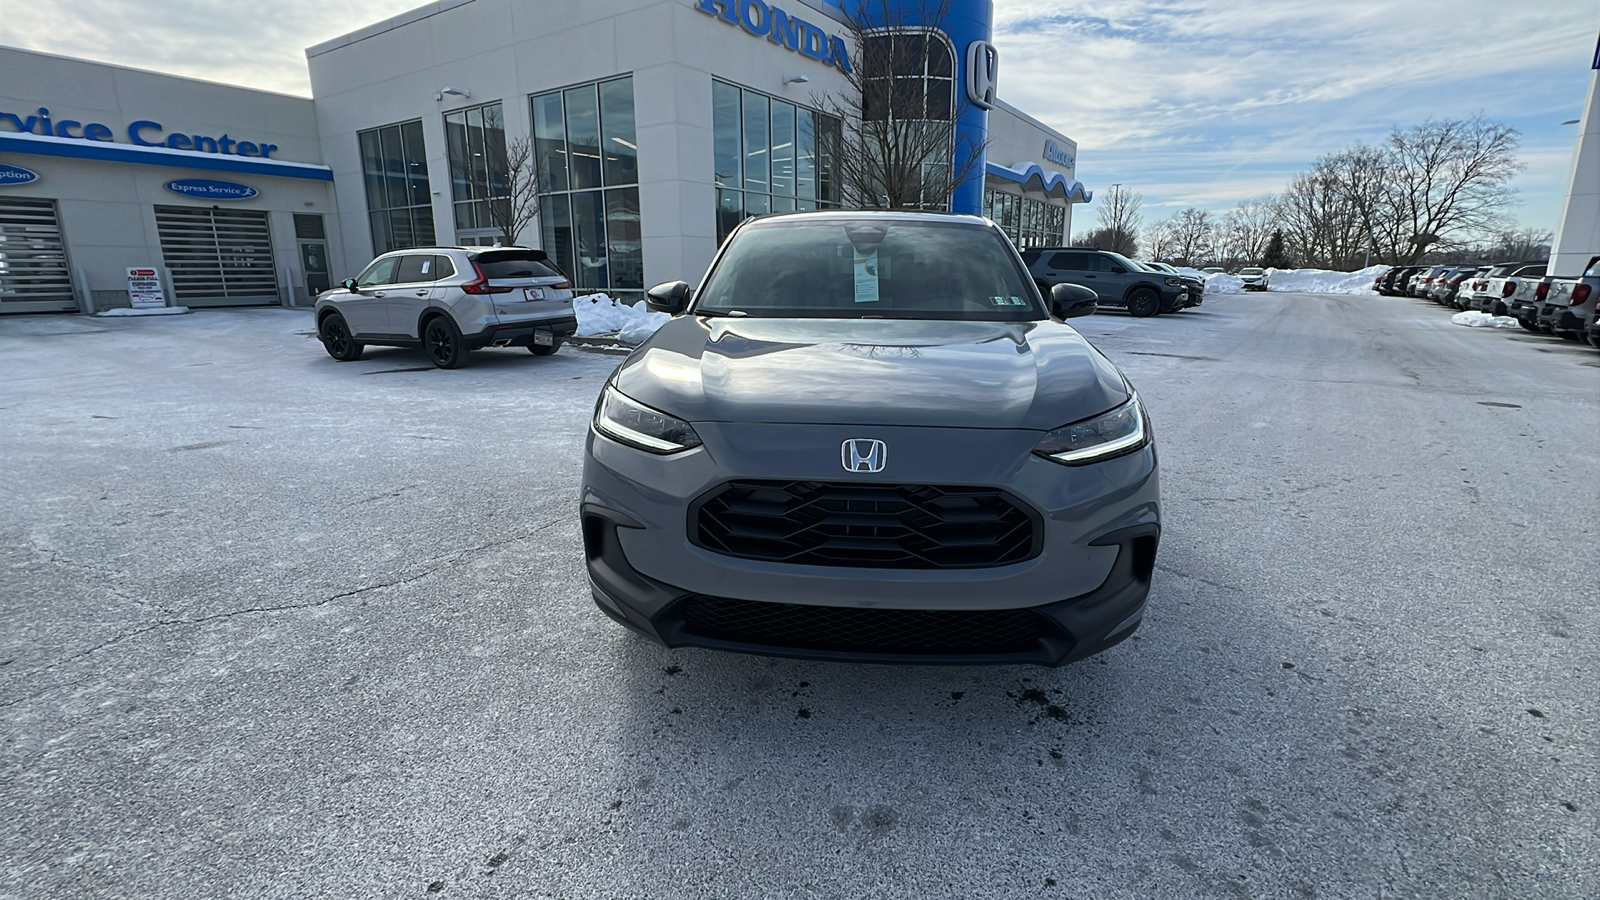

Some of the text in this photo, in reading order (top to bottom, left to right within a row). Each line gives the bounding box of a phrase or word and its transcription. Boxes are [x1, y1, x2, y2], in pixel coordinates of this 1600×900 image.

[695, 0, 853, 73] HONDA
[128, 120, 278, 158] Center
[171, 183, 241, 195] Express Service
